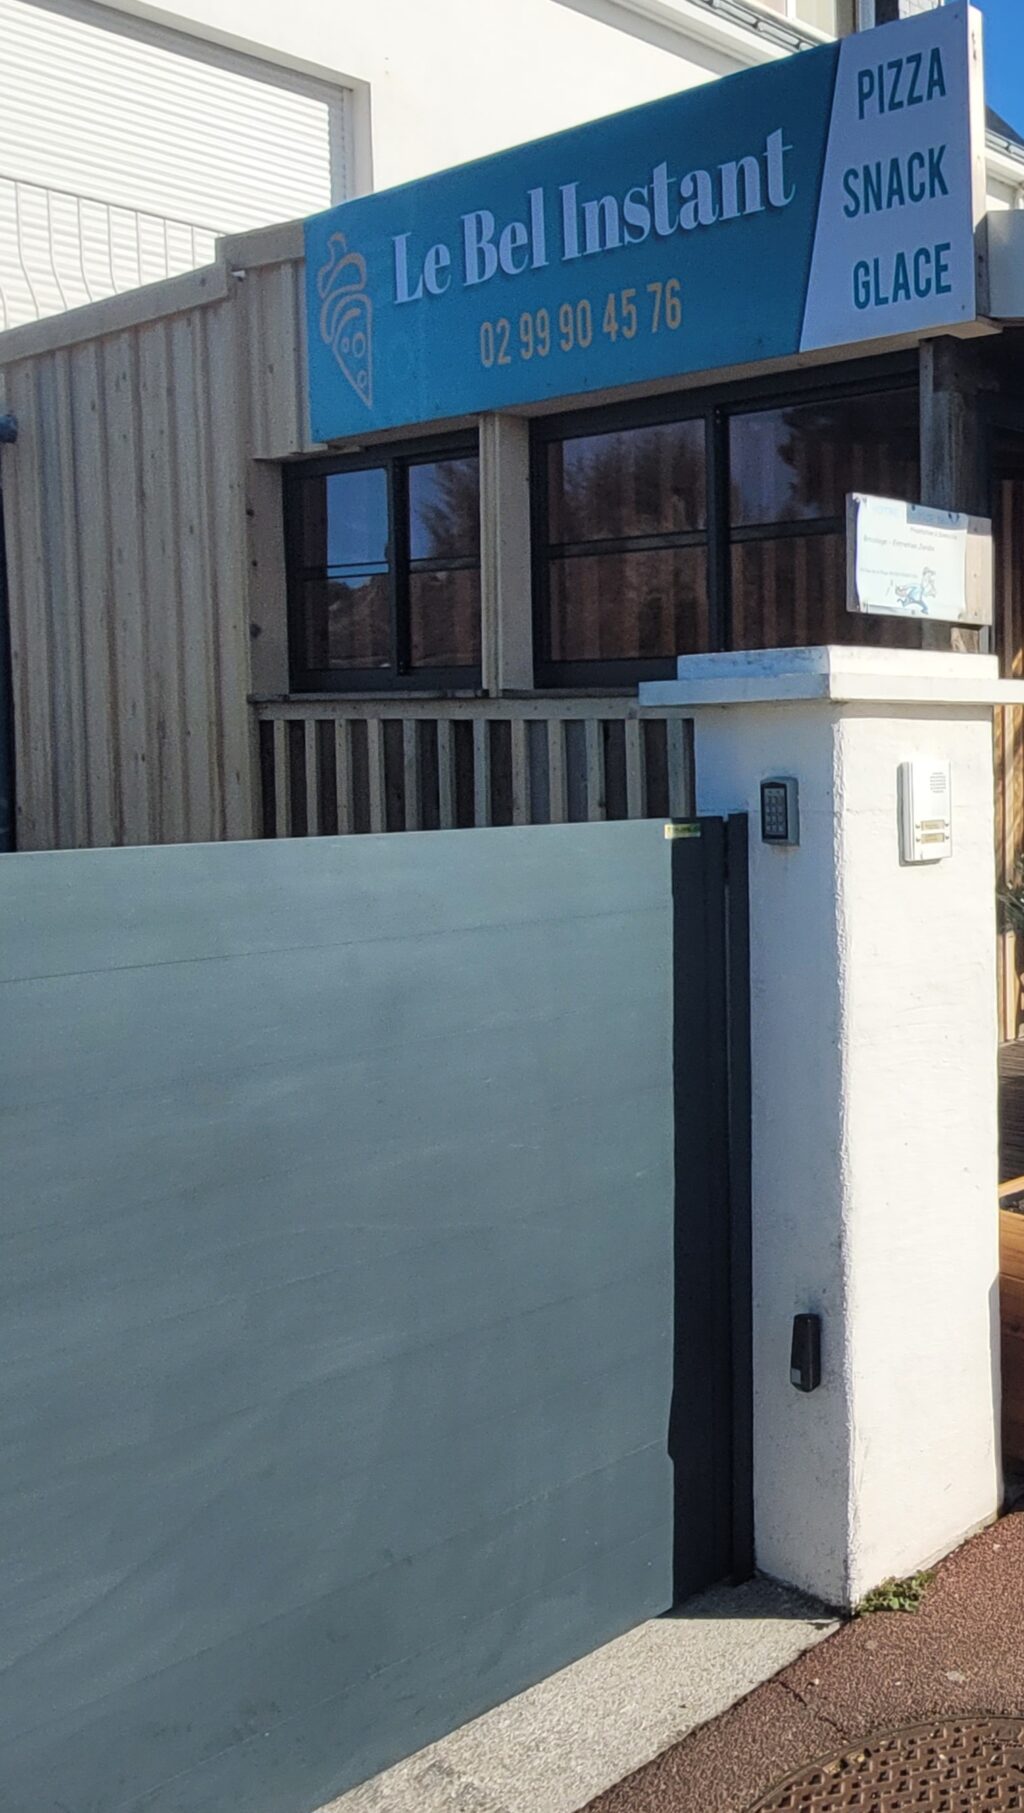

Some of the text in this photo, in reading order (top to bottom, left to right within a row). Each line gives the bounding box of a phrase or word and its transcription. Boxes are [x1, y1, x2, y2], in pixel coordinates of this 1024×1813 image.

[859, 46, 946, 120] PIZZA
[392, 127, 796, 304] Le Bel Instant
[843, 144, 949, 218] SNACK
[852, 241, 952, 311] GLACE
[480, 277, 682, 369] 02 99 90 45 76
